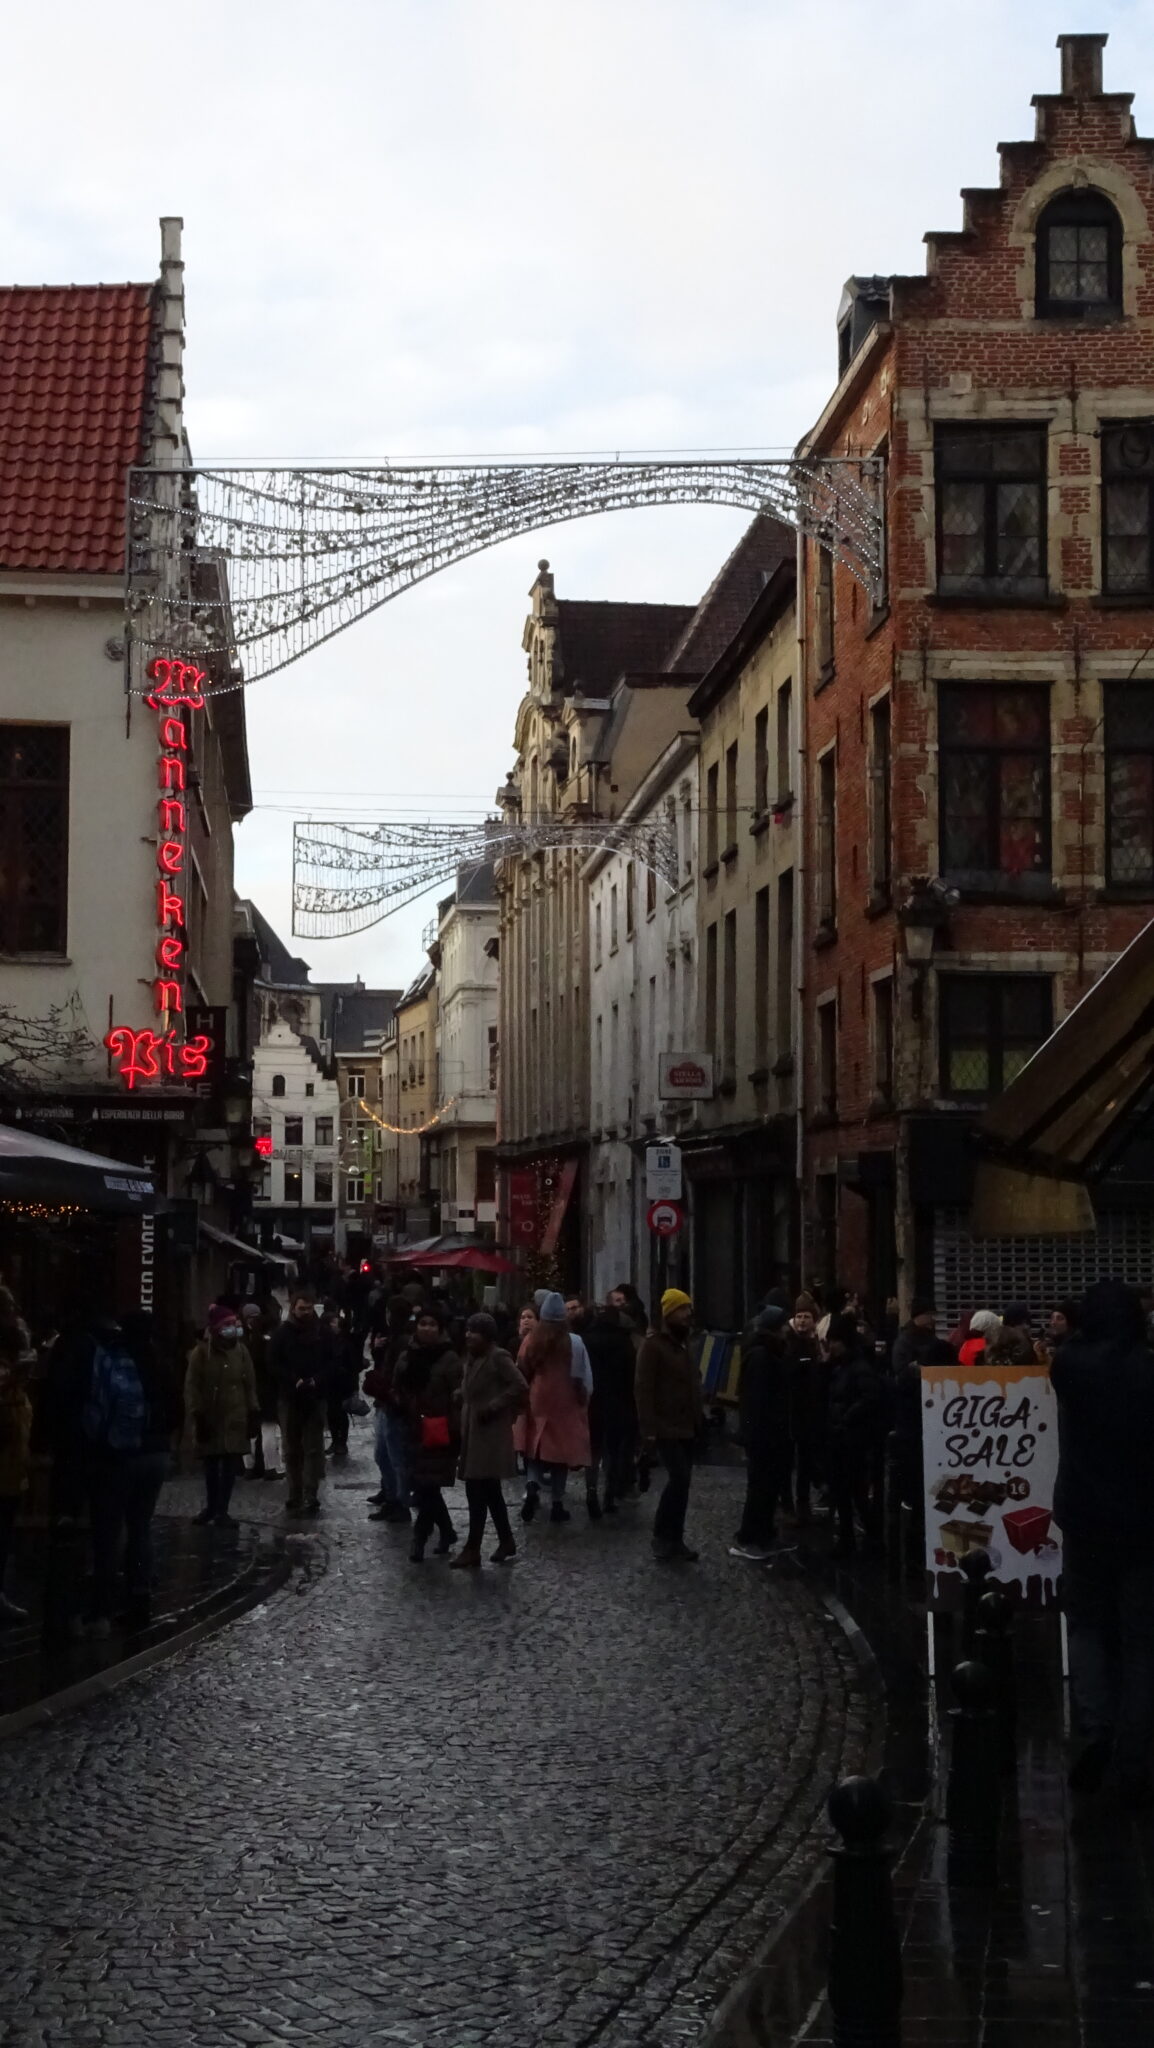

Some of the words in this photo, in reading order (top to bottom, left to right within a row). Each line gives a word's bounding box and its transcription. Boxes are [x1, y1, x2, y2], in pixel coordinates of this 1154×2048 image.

[147, 658, 206, 1014] Manneken
[105, 1027, 210, 1090] Pis
[943, 1395, 1031, 1429] GIGA
[945, 1434, 1036, 1468] SALE
[1010, 1482, 1026, 1496] 1€
